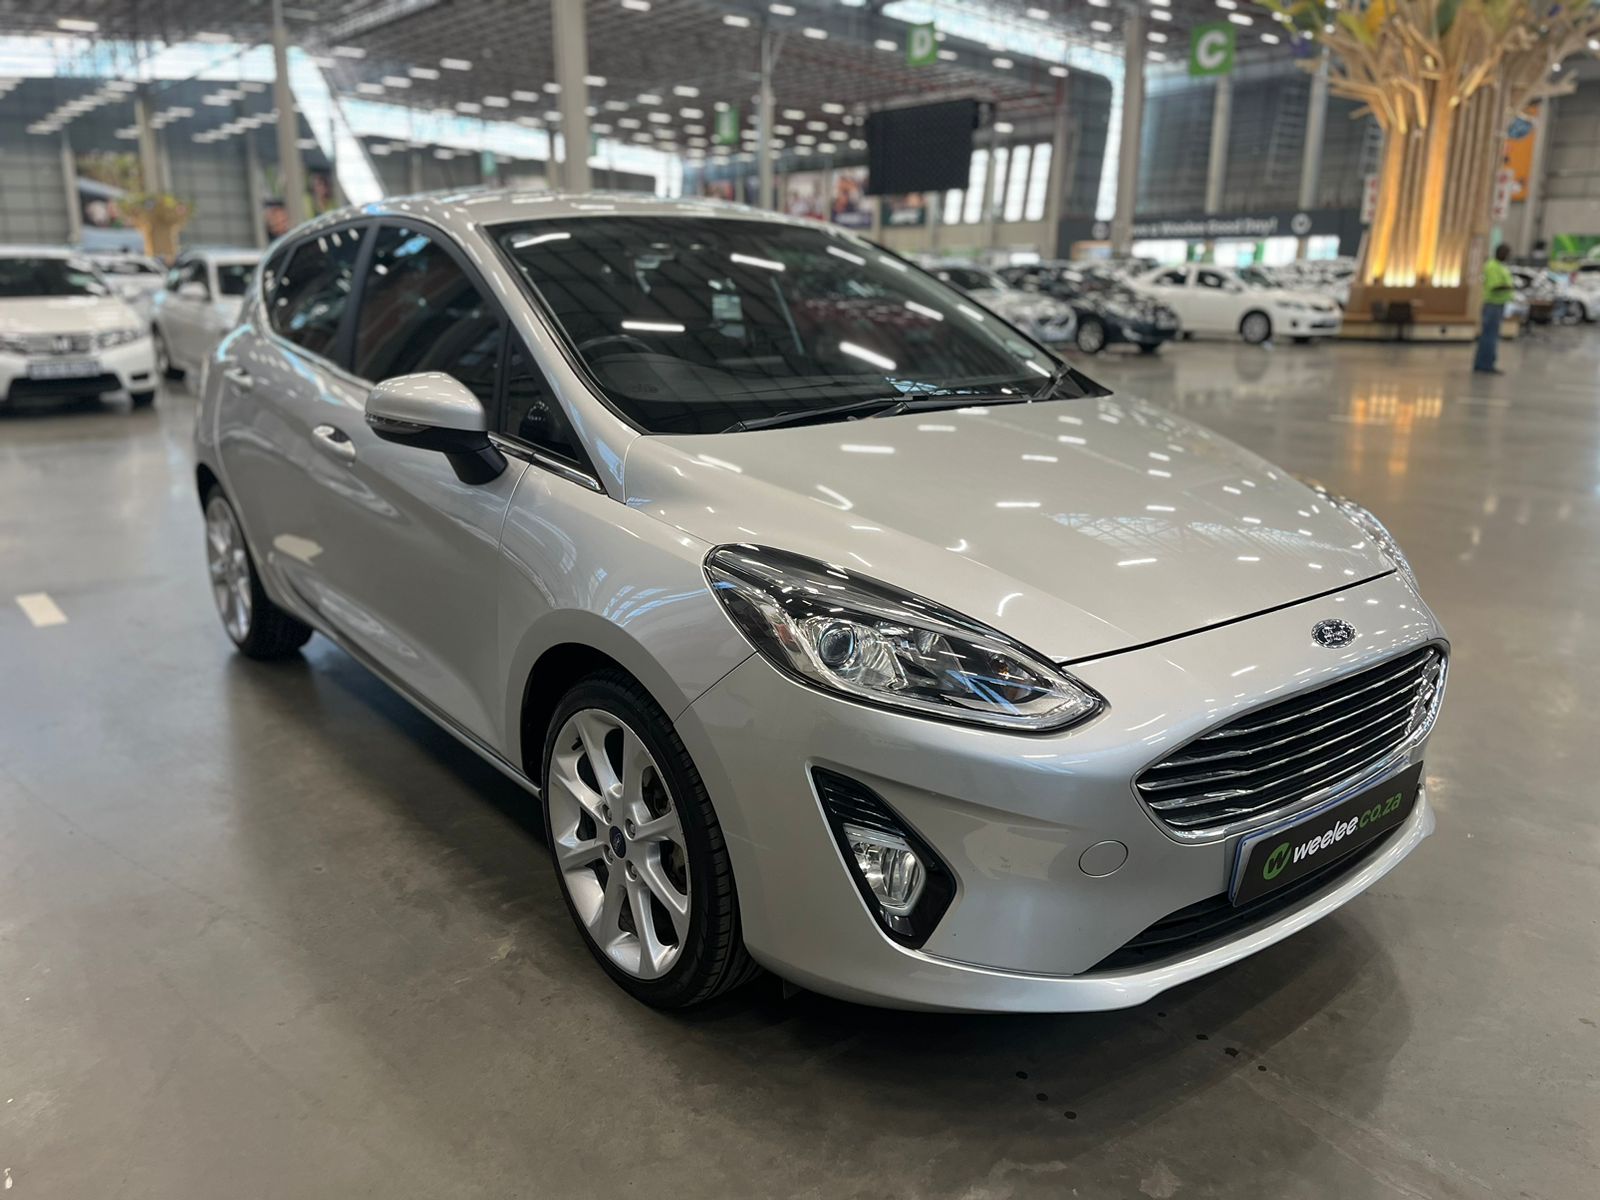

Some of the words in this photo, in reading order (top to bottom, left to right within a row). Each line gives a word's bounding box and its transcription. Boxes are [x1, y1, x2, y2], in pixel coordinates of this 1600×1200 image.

[911, 29, 932, 58] D
[1196, 30, 1228, 70] C
[1292, 792, 1403, 864] weelee.co.za
